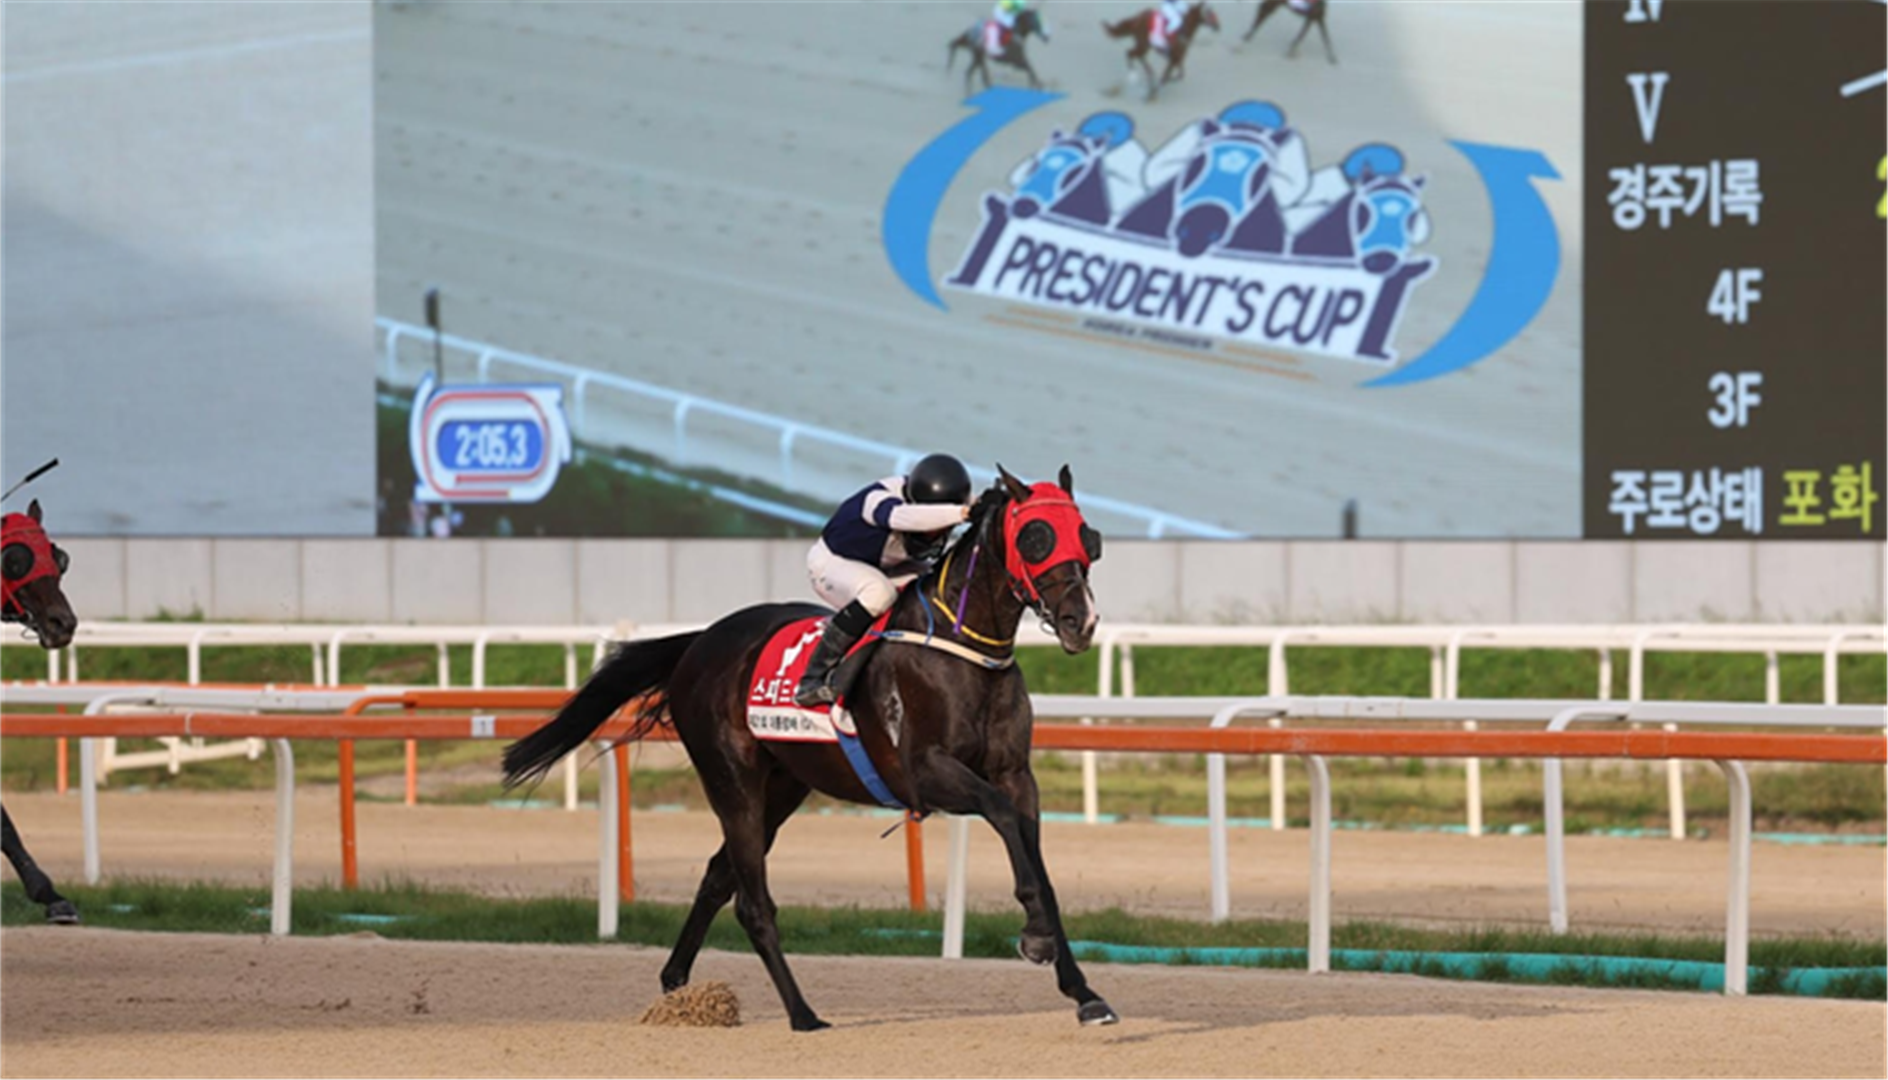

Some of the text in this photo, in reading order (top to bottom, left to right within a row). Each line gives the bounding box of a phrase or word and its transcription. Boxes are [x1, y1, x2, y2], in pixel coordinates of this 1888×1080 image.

[1626, 72, 1669, 143] V
[1608, 160, 1762, 229] 경주기록
[993, 235, 1365, 346] PRESIDENT'S CUP
[1707, 269, 1762, 323] 4F
[1707, 372, 1762, 427] 3F
[1608, 466, 1763, 534] 주로상태
